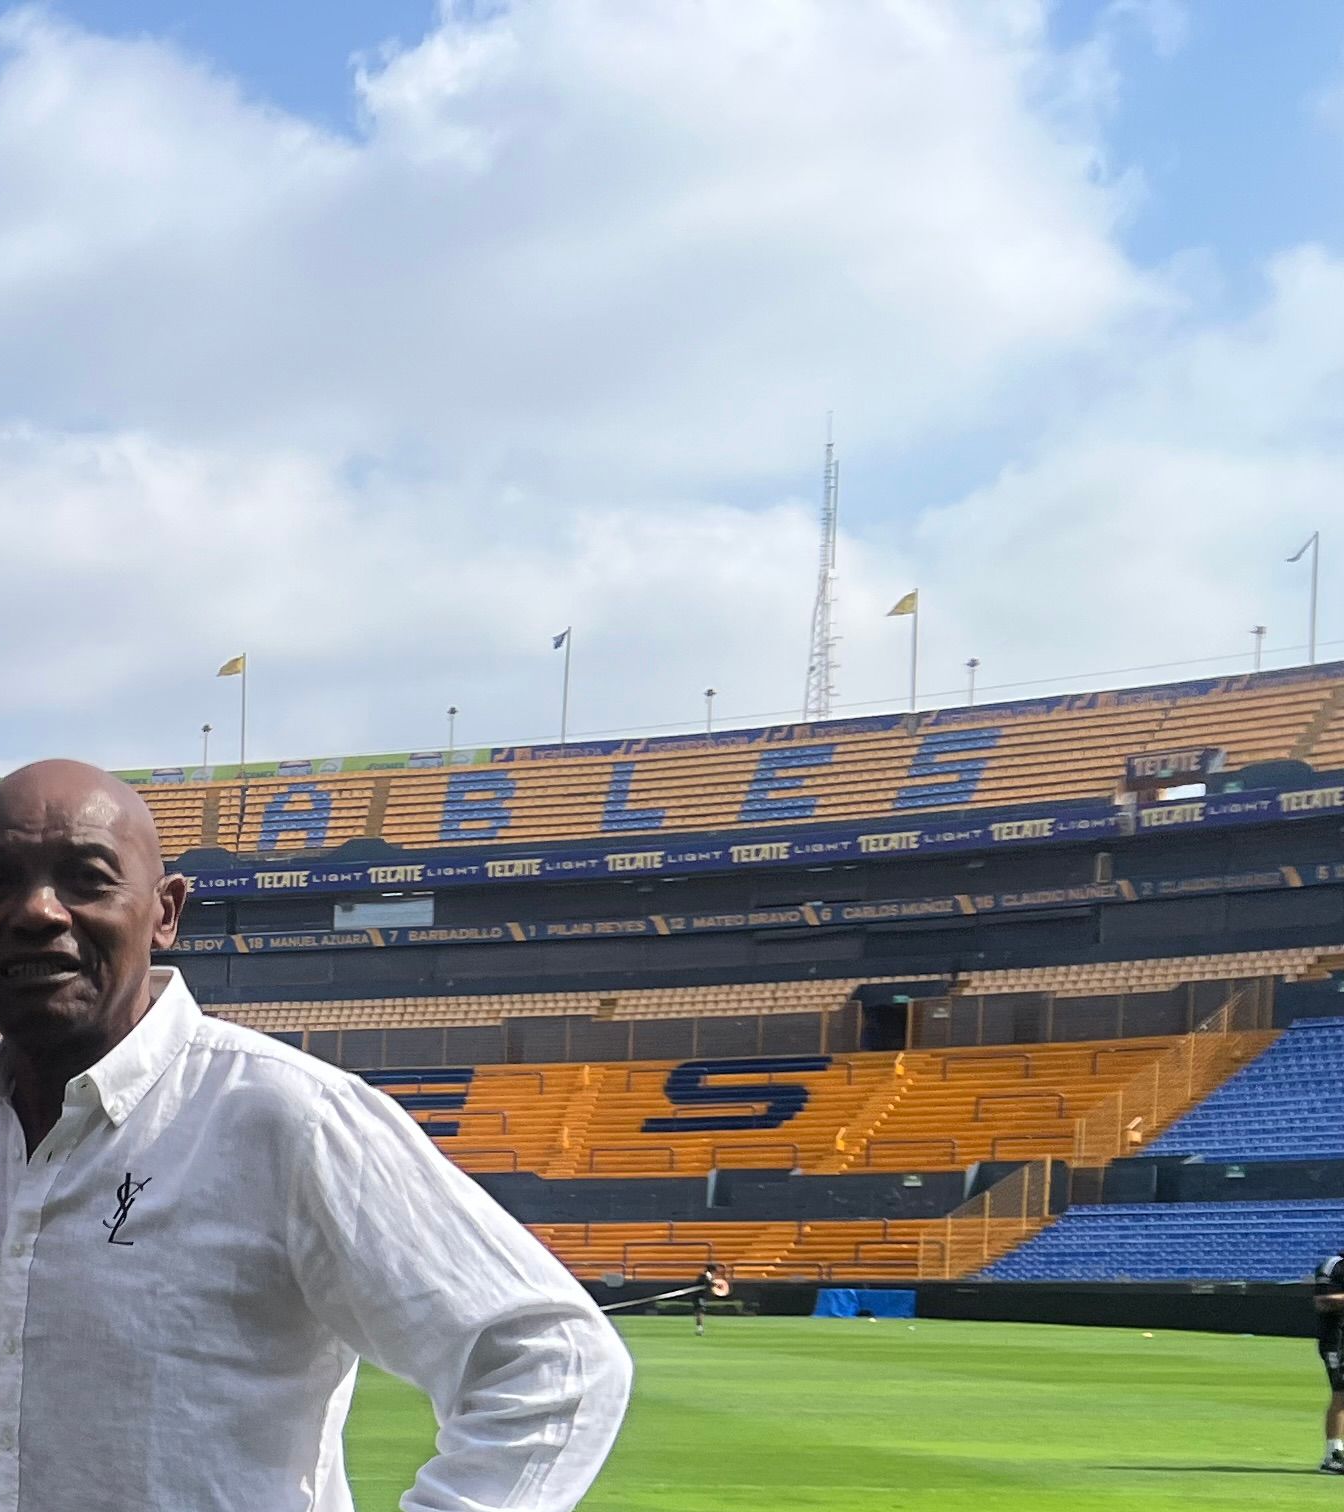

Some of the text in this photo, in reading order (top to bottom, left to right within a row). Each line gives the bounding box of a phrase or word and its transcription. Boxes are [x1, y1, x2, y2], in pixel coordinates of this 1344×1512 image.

[1278, 786, 1344, 813] TECATE
[1140, 799, 1273, 827] TECATE LIGHT
[989, 817, 1118, 841] TECATE LIGHT
[857, 829, 982, 853] TECATE LIGHT
[604, 851, 723, 872] TECATE LIGHT
[729, 841, 852, 863] TECATE LIGHT
[367, 864, 479, 884] TECATE LIGHT
[485, 858, 599, 878] TECATE LIGHT
[199, 877, 250, 889] LIGHT
[254, 870, 363, 889] TECATE LIGHT
[692, 914, 745, 928] MATEO
[748, 910, 801, 926] BRAVO
[842, 904, 897, 920] CARLOS
[389, 927, 503, 943] 7 BARBADILLO
[547, 923, 593, 936] PILAR
[194, 940, 225, 951] BOY
[270, 936, 318, 948] MANUEL
[321, 934, 369, 946] AZUARA
